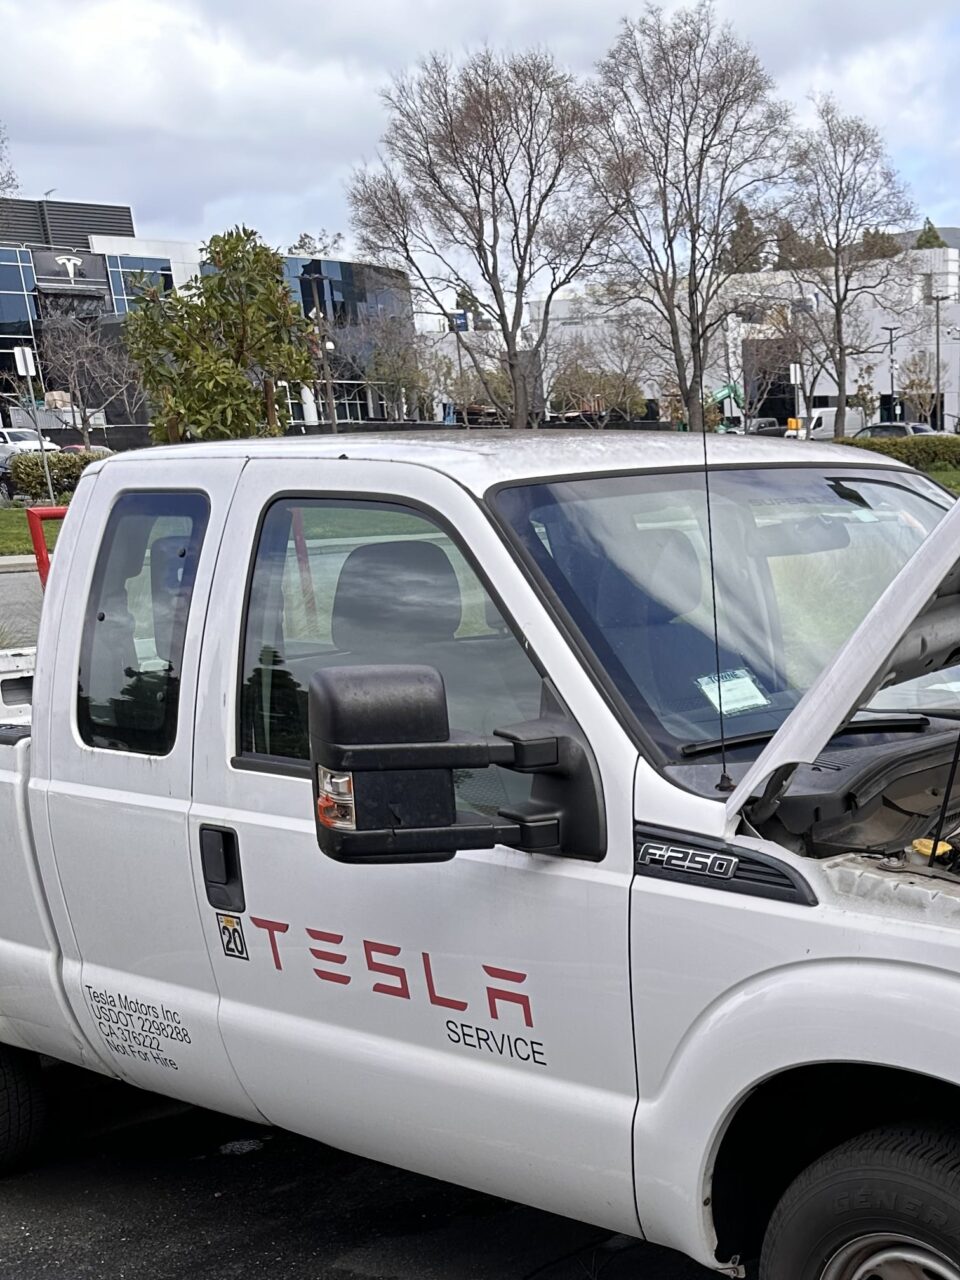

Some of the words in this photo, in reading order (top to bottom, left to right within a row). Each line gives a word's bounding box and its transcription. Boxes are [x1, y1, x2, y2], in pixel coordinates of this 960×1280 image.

[638, 843, 739, 878] F-250
[222, 925, 244, 955] 20
[249, 916, 533, 1028] TESLA
[85, 985, 116, 1008] Tesla
[118, 993, 159, 1019] Motors
[161, 1004, 181, 1025] Inc
[91, 1003, 135, 1029] USDOT
[138, 1016, 191, 1044] 2298288
[98, 1021, 119, 1040] CA
[117, 1027, 164, 1052] 376222
[105, 1038, 131, 1057] Not
[128, 1044, 150, 1063] For
[150, 1050, 178, 1070] Hire
[445, 1020, 547, 1066] SERVICE
